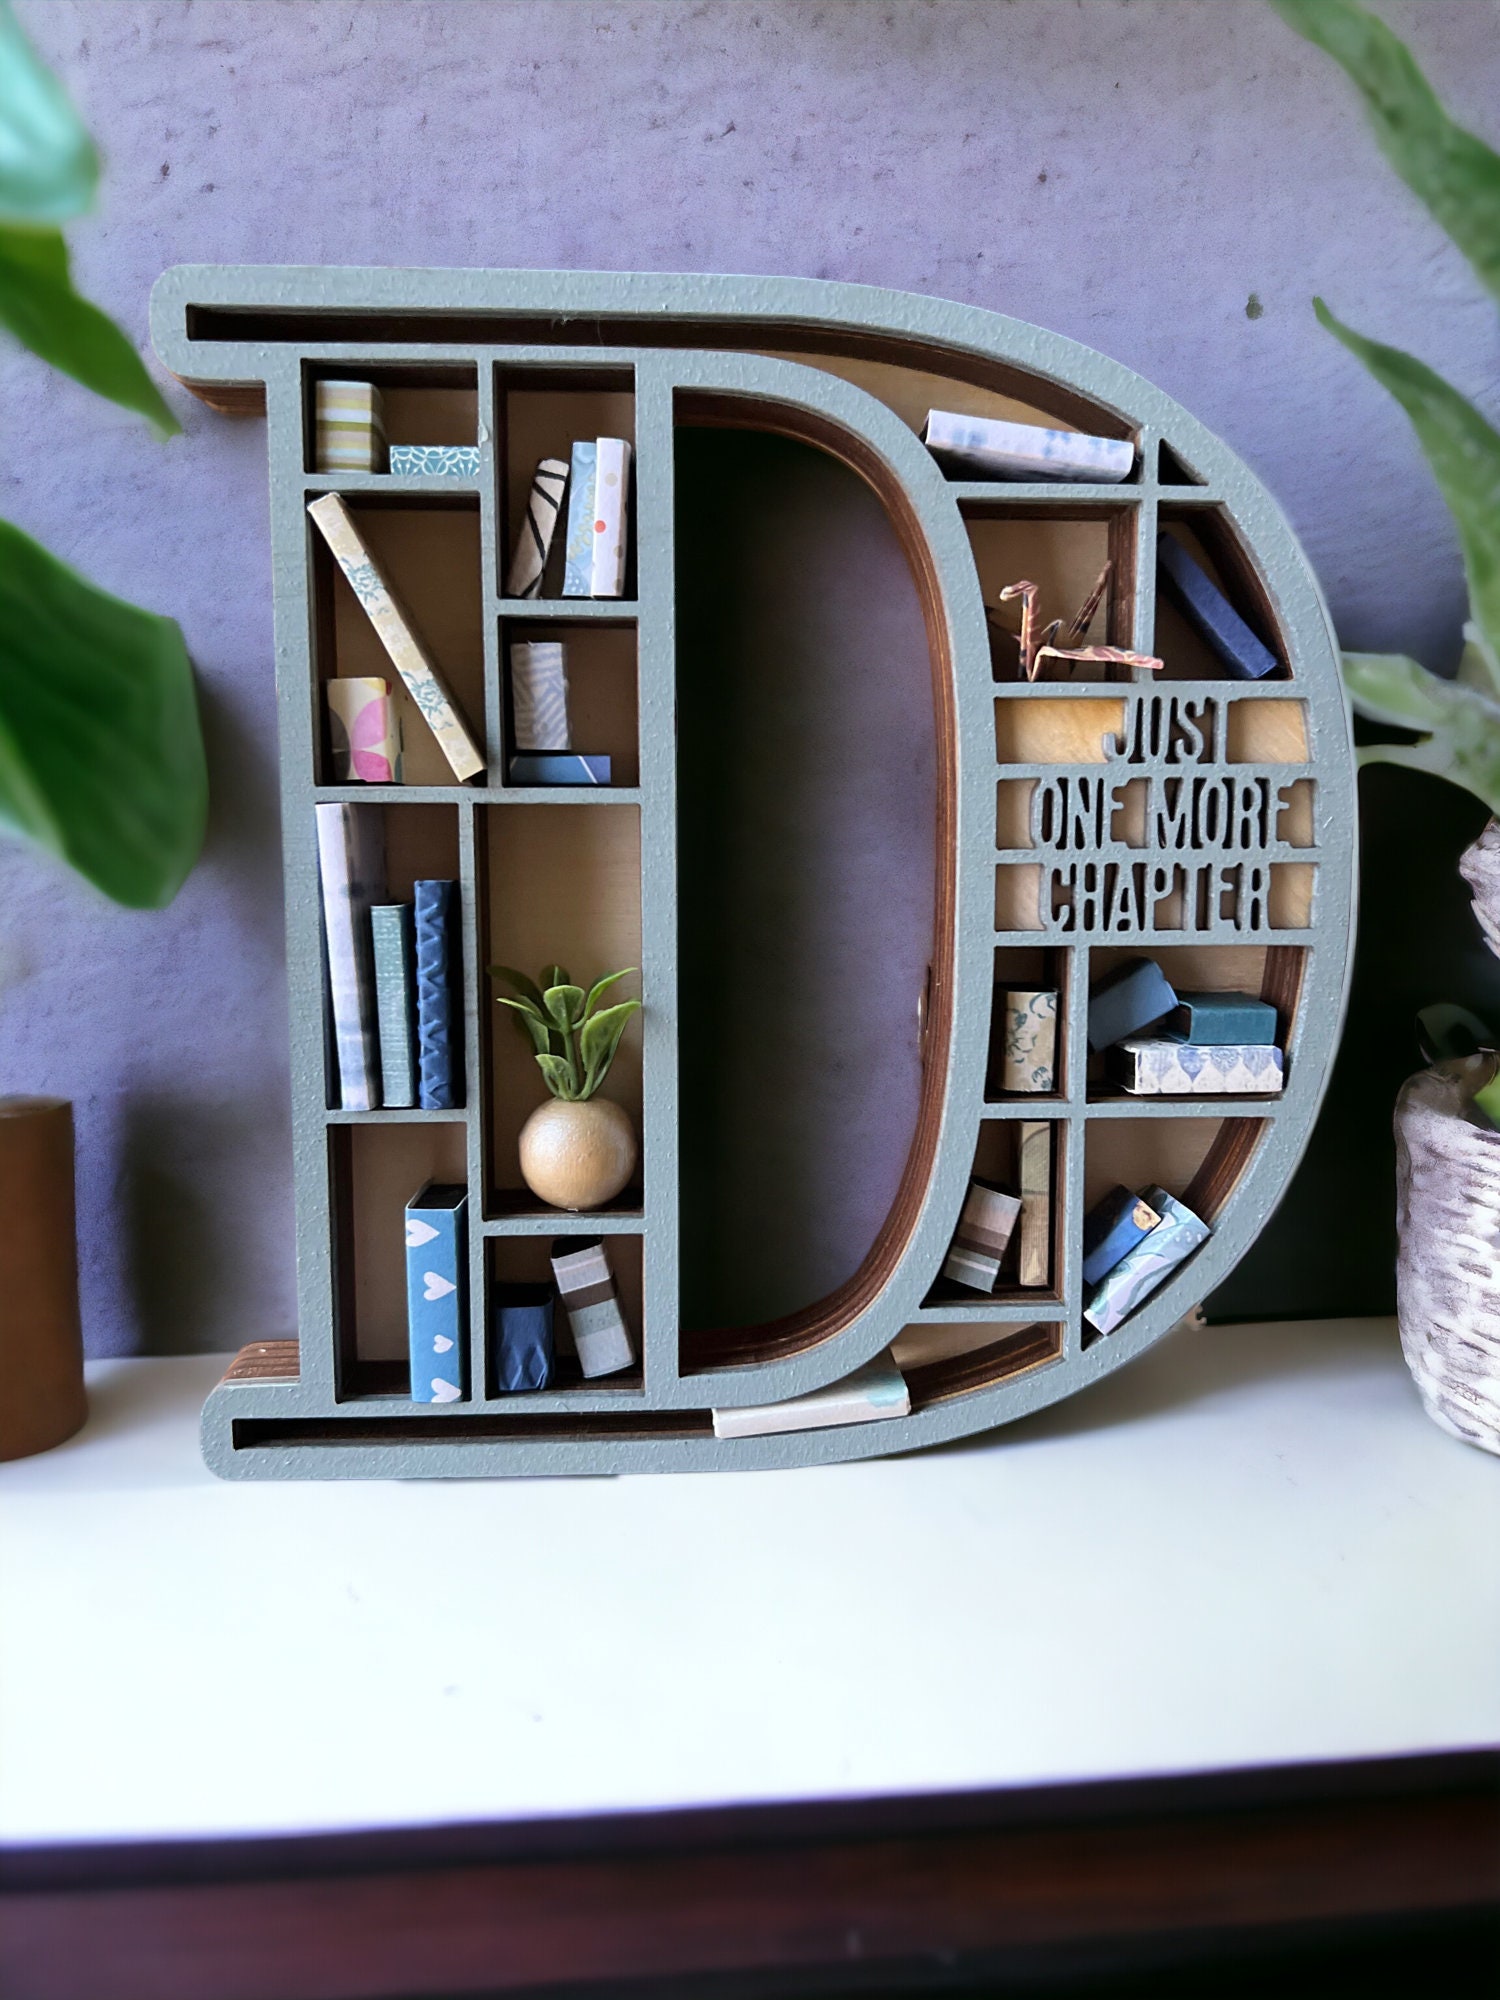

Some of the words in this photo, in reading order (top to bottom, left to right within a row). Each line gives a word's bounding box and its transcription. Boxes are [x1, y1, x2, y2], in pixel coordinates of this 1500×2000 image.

[1102, 695, 1239, 765] JUST
[1030, 776, 1131, 851] ONE
[1147, 776, 1298, 850] MORE
[1039, 862, 1271, 932] CHAPTER
